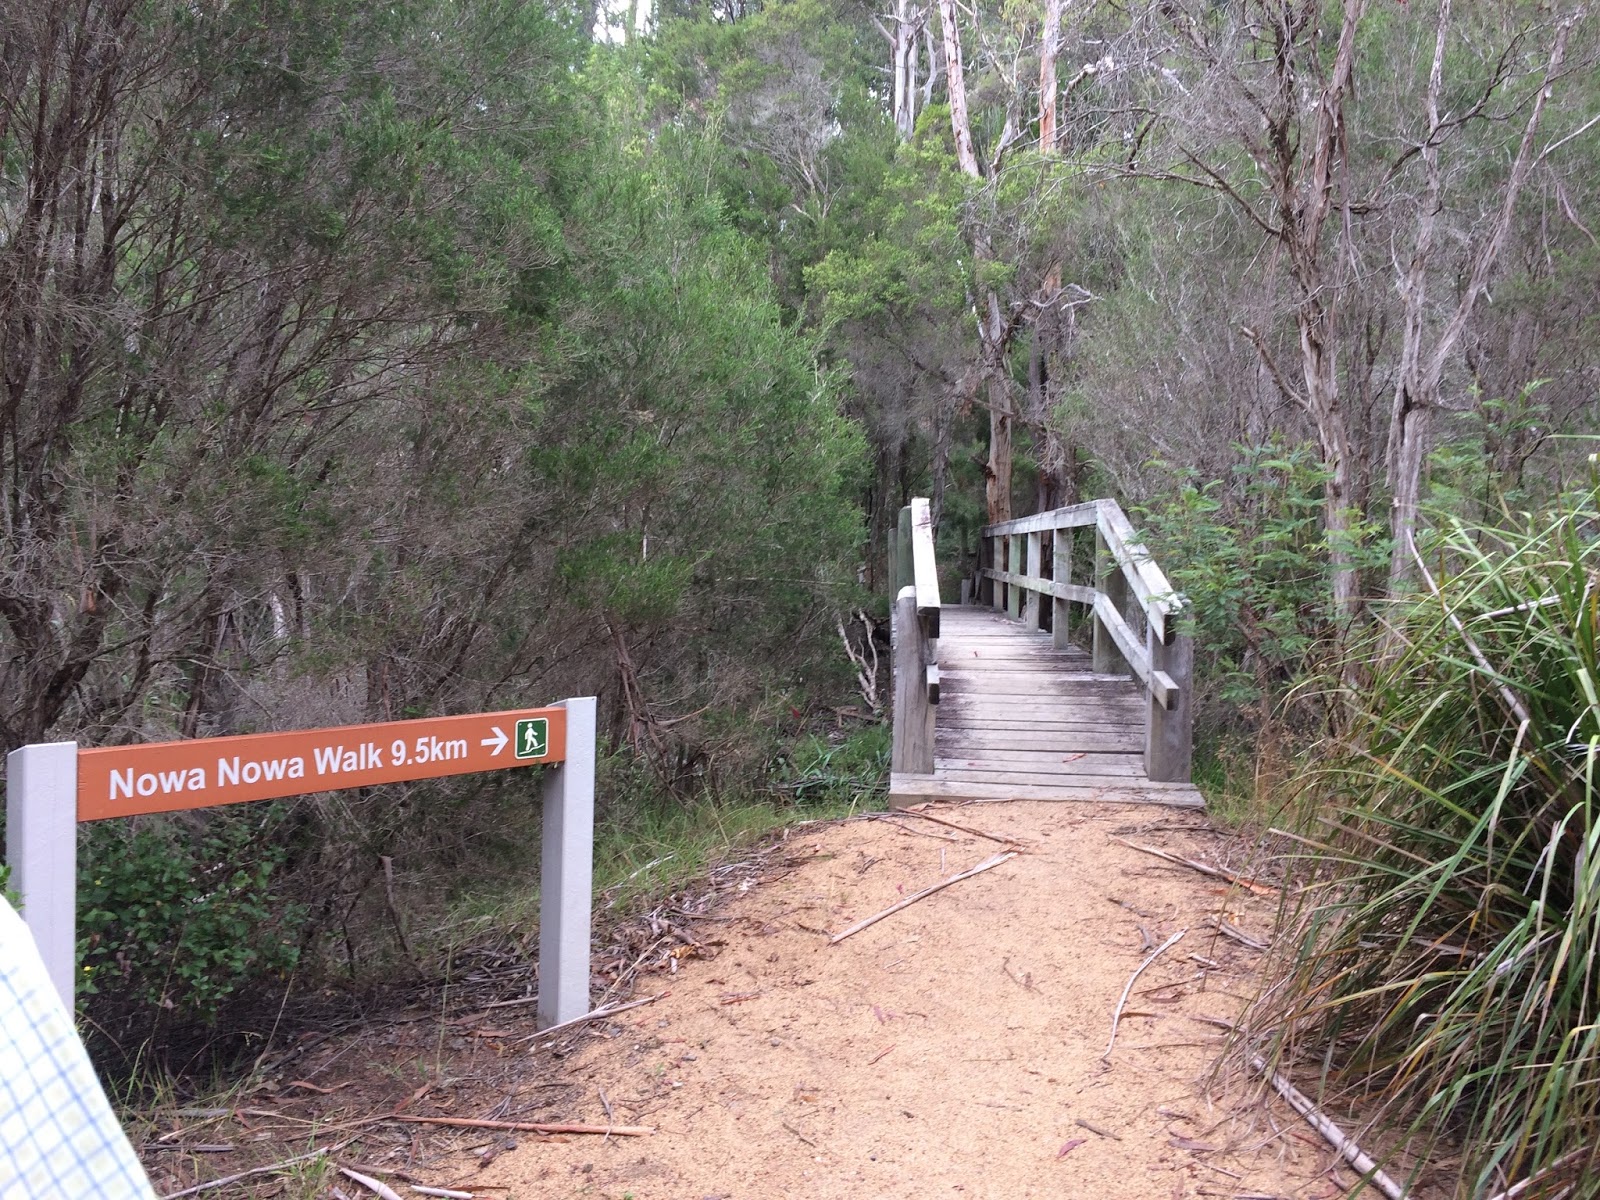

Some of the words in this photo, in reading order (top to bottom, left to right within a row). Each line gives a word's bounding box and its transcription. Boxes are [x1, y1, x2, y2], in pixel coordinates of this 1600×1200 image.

[108, 767, 207, 801] Nowa
[216, 755, 305, 788] Nowa
[312, 742, 384, 776] Walk
[390, 735, 469, 768] 9.5km
